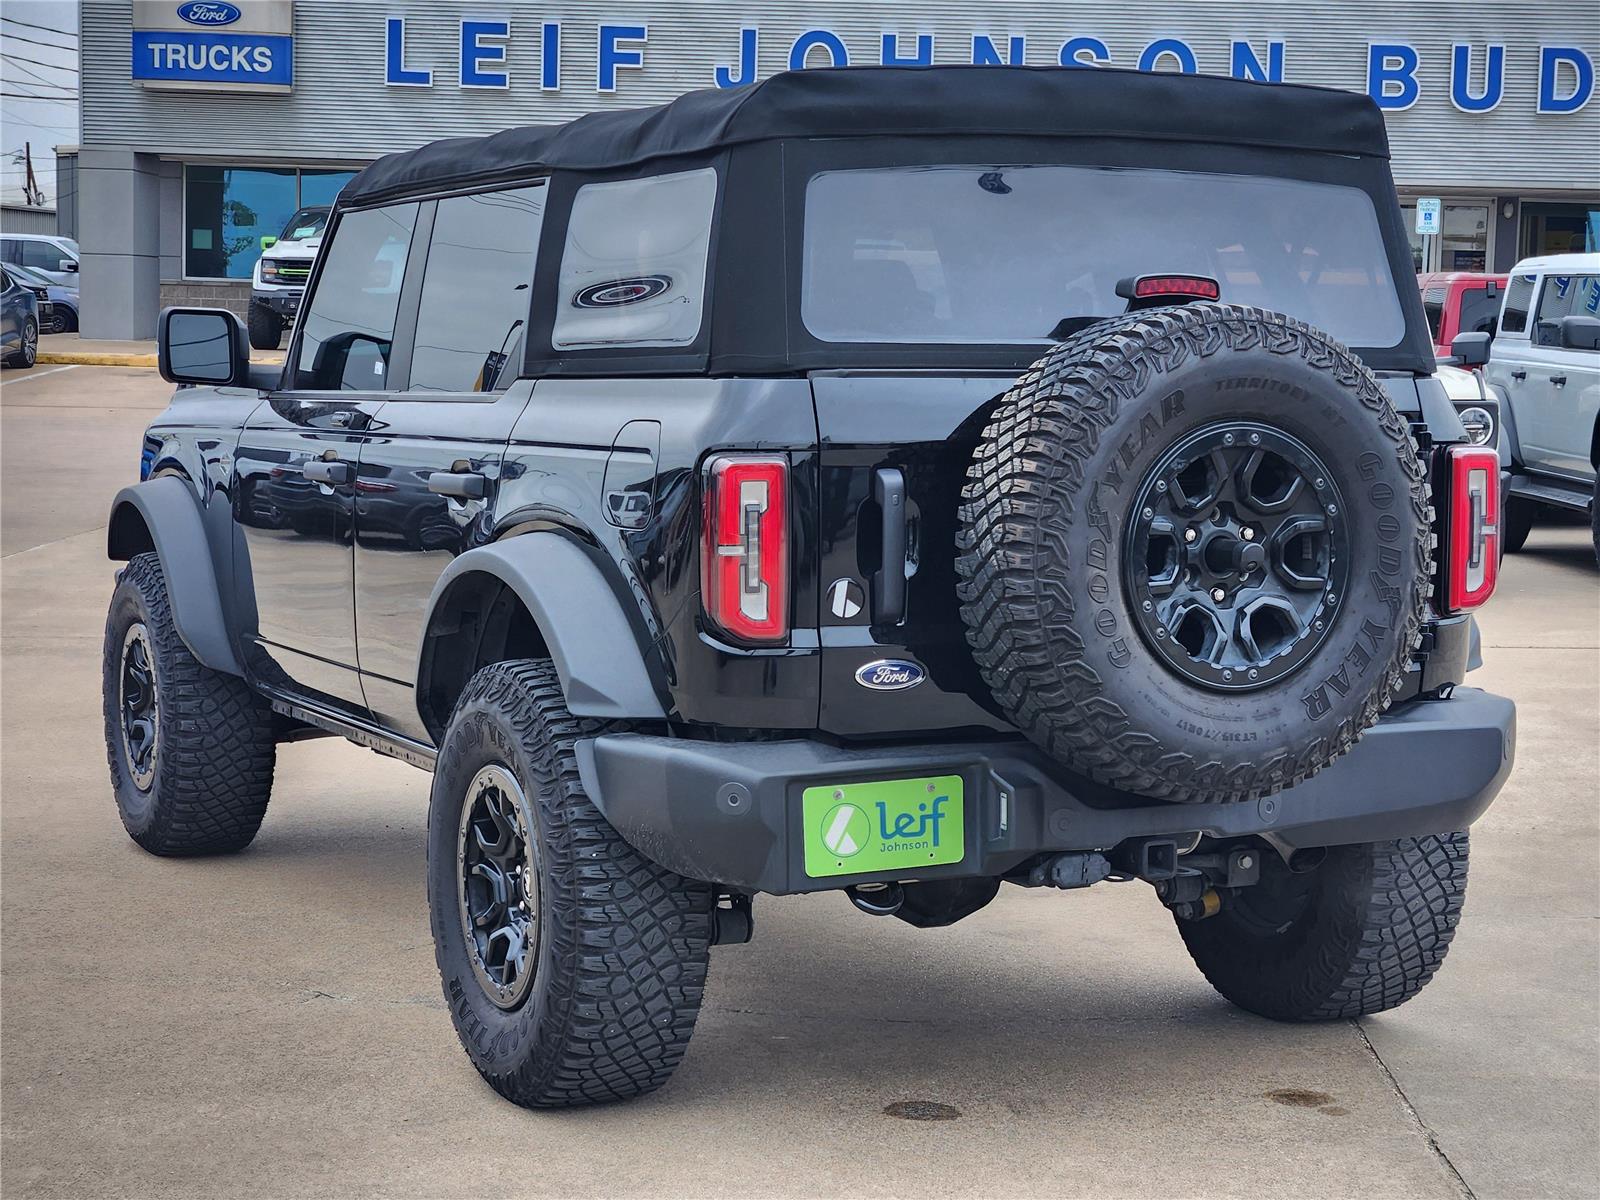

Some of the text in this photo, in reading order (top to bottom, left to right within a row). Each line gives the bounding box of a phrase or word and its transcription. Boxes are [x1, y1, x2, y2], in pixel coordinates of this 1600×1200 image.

[189, 3, 227, 21] Ford
[147, 43, 273, 73] TRUCKS
[384, 17, 649, 93] LEIF
[1367, 41, 1597, 115] BUD
[1086, 388, 1186, 668] GOODYEAR
[1301, 450, 1402, 722] GOODYEAR
[872, 666, 910, 684] Ford
[875, 796, 949, 847] leif
[880, 841, 928, 853] Johnson
